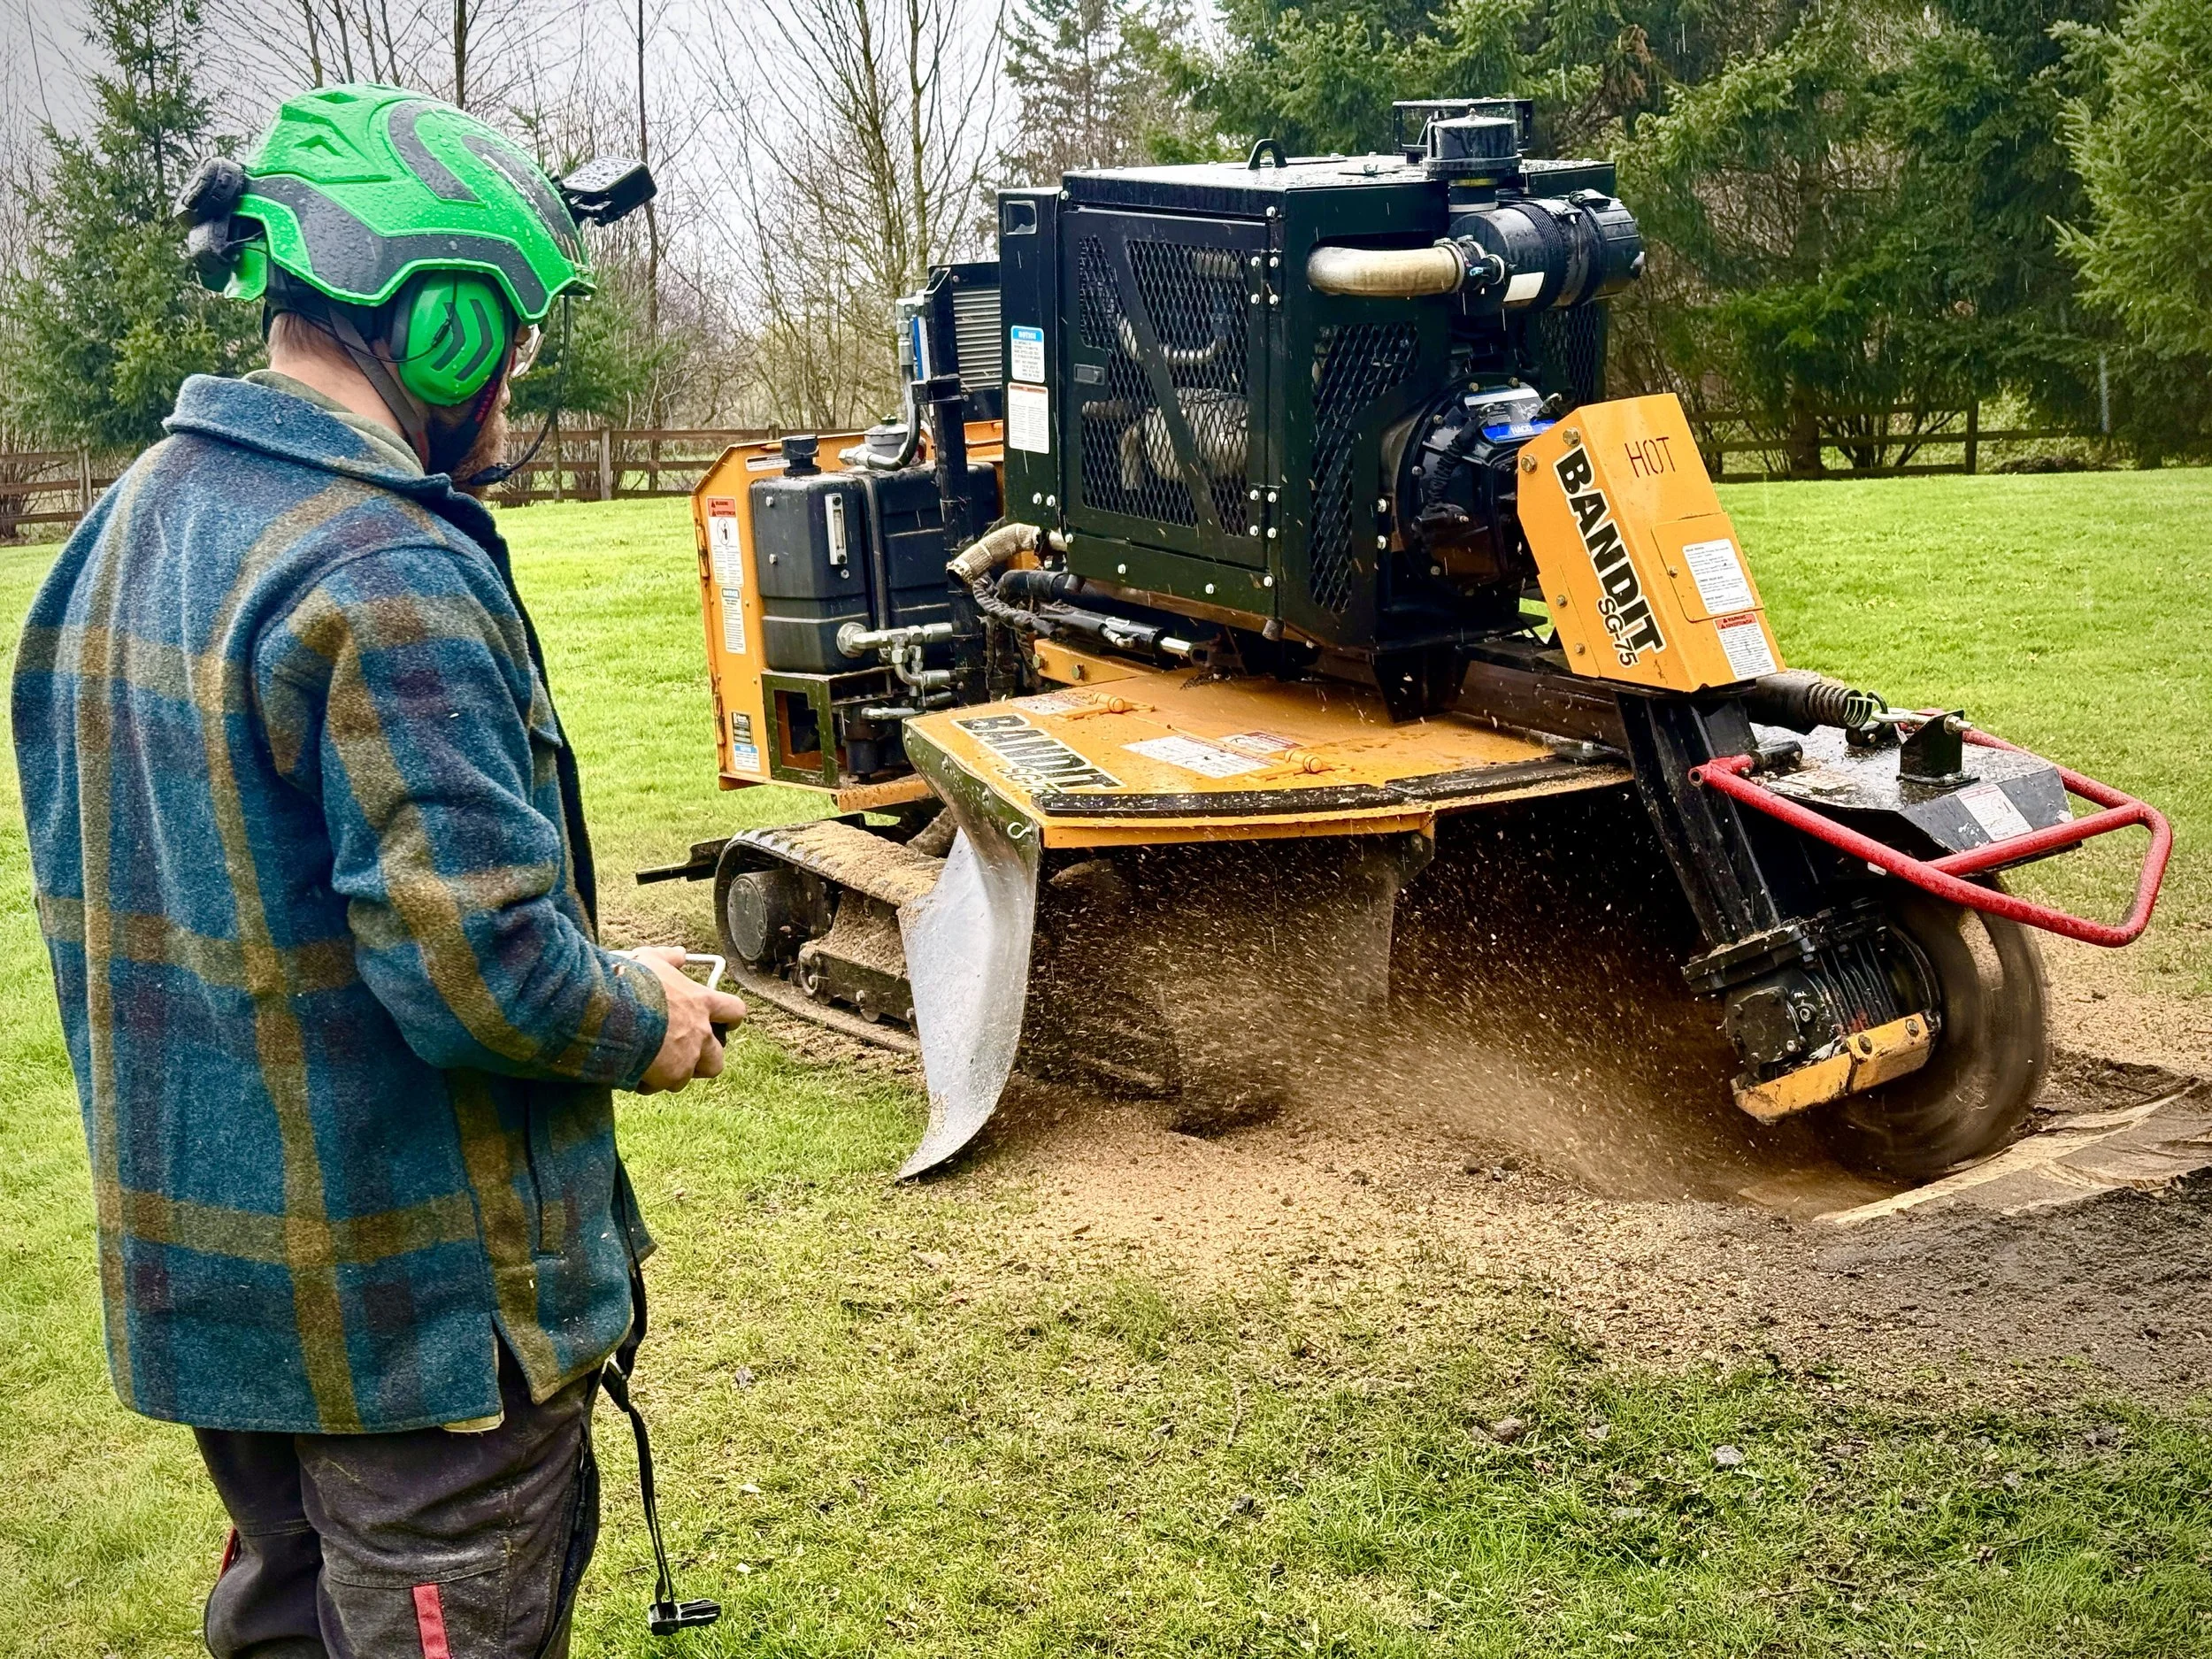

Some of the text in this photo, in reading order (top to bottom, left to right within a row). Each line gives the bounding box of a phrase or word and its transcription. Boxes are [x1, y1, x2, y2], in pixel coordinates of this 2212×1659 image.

[1624, 436, 1676, 478] HOT
[1555, 446, 1664, 651] BANDIT
[1597, 597, 1639, 666] SG-75
[955, 713, 1123, 788] BANDIT
